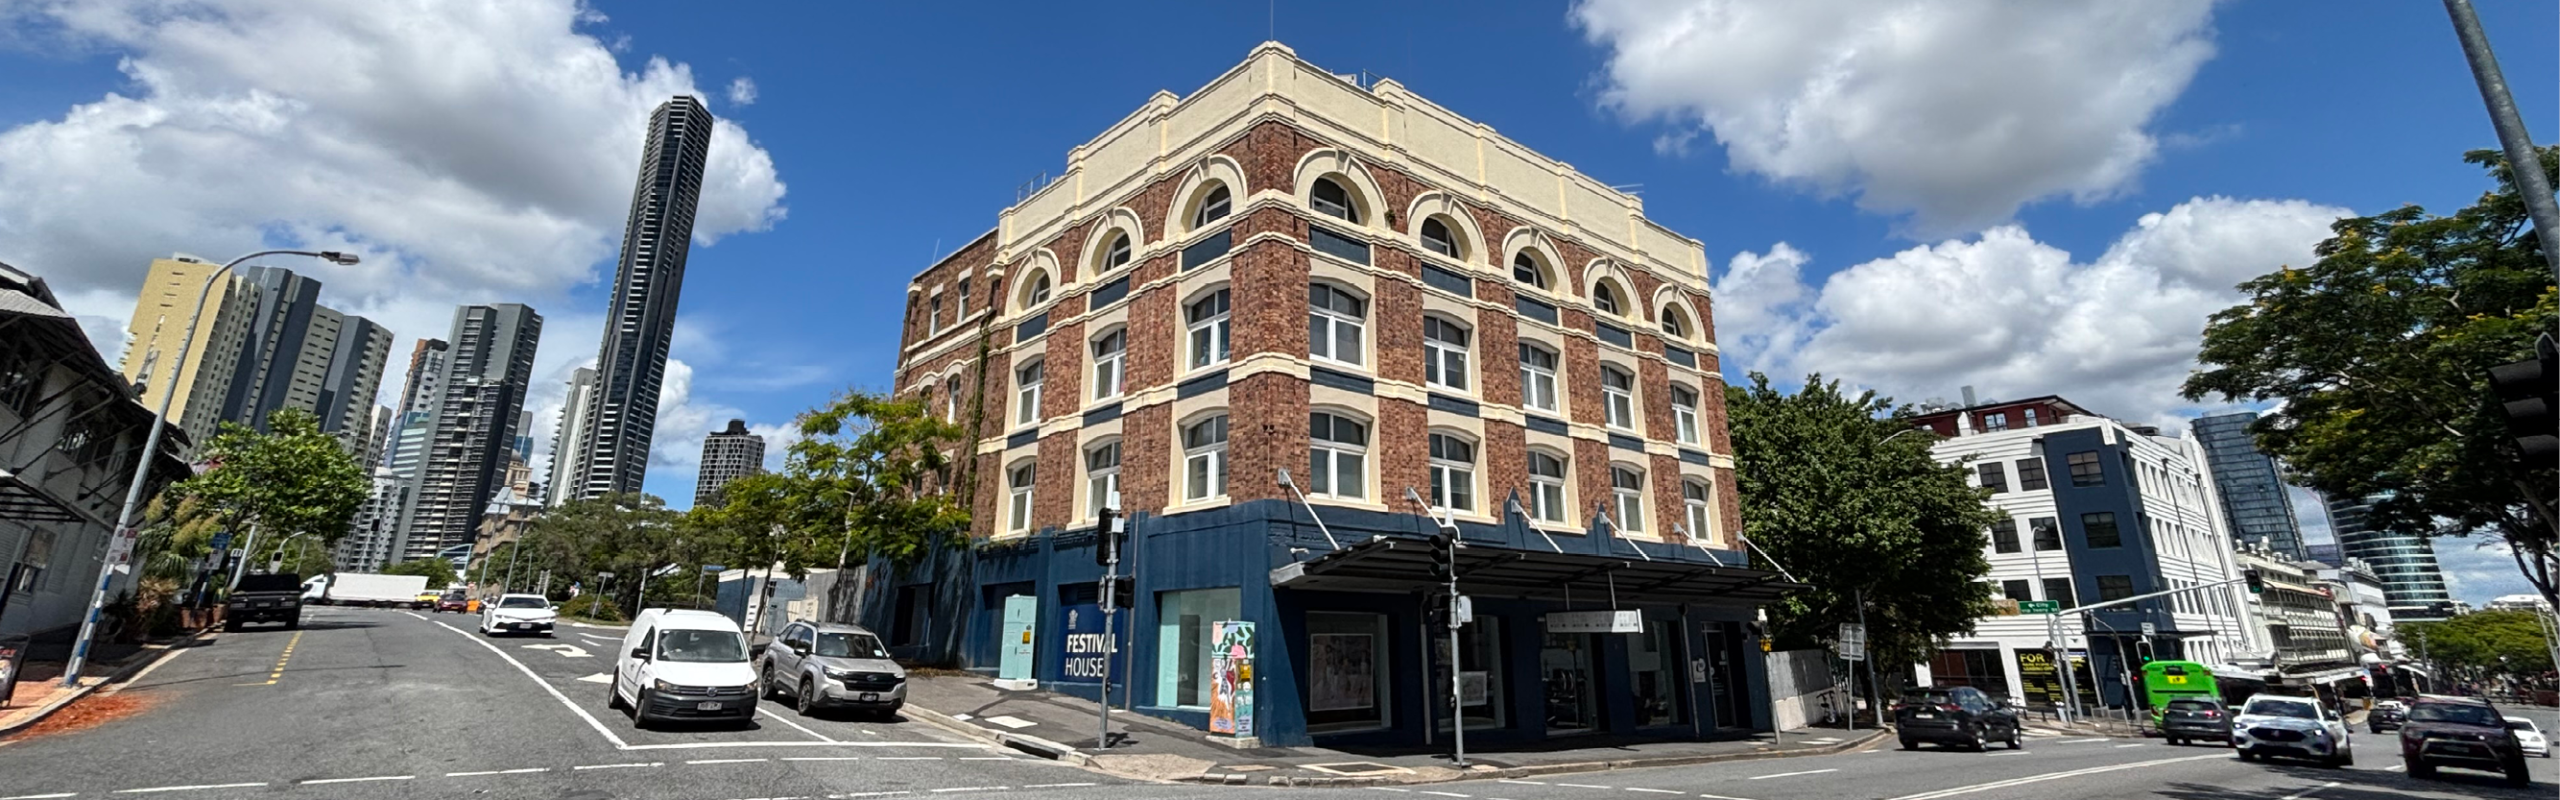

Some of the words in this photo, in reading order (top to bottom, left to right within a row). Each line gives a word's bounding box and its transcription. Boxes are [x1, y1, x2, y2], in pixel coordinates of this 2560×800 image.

[1066, 633, 1118, 653] FESTIVL
[1065, 657, 1104, 677] HOUSE
[2020, 653, 2045, 662] FOR
